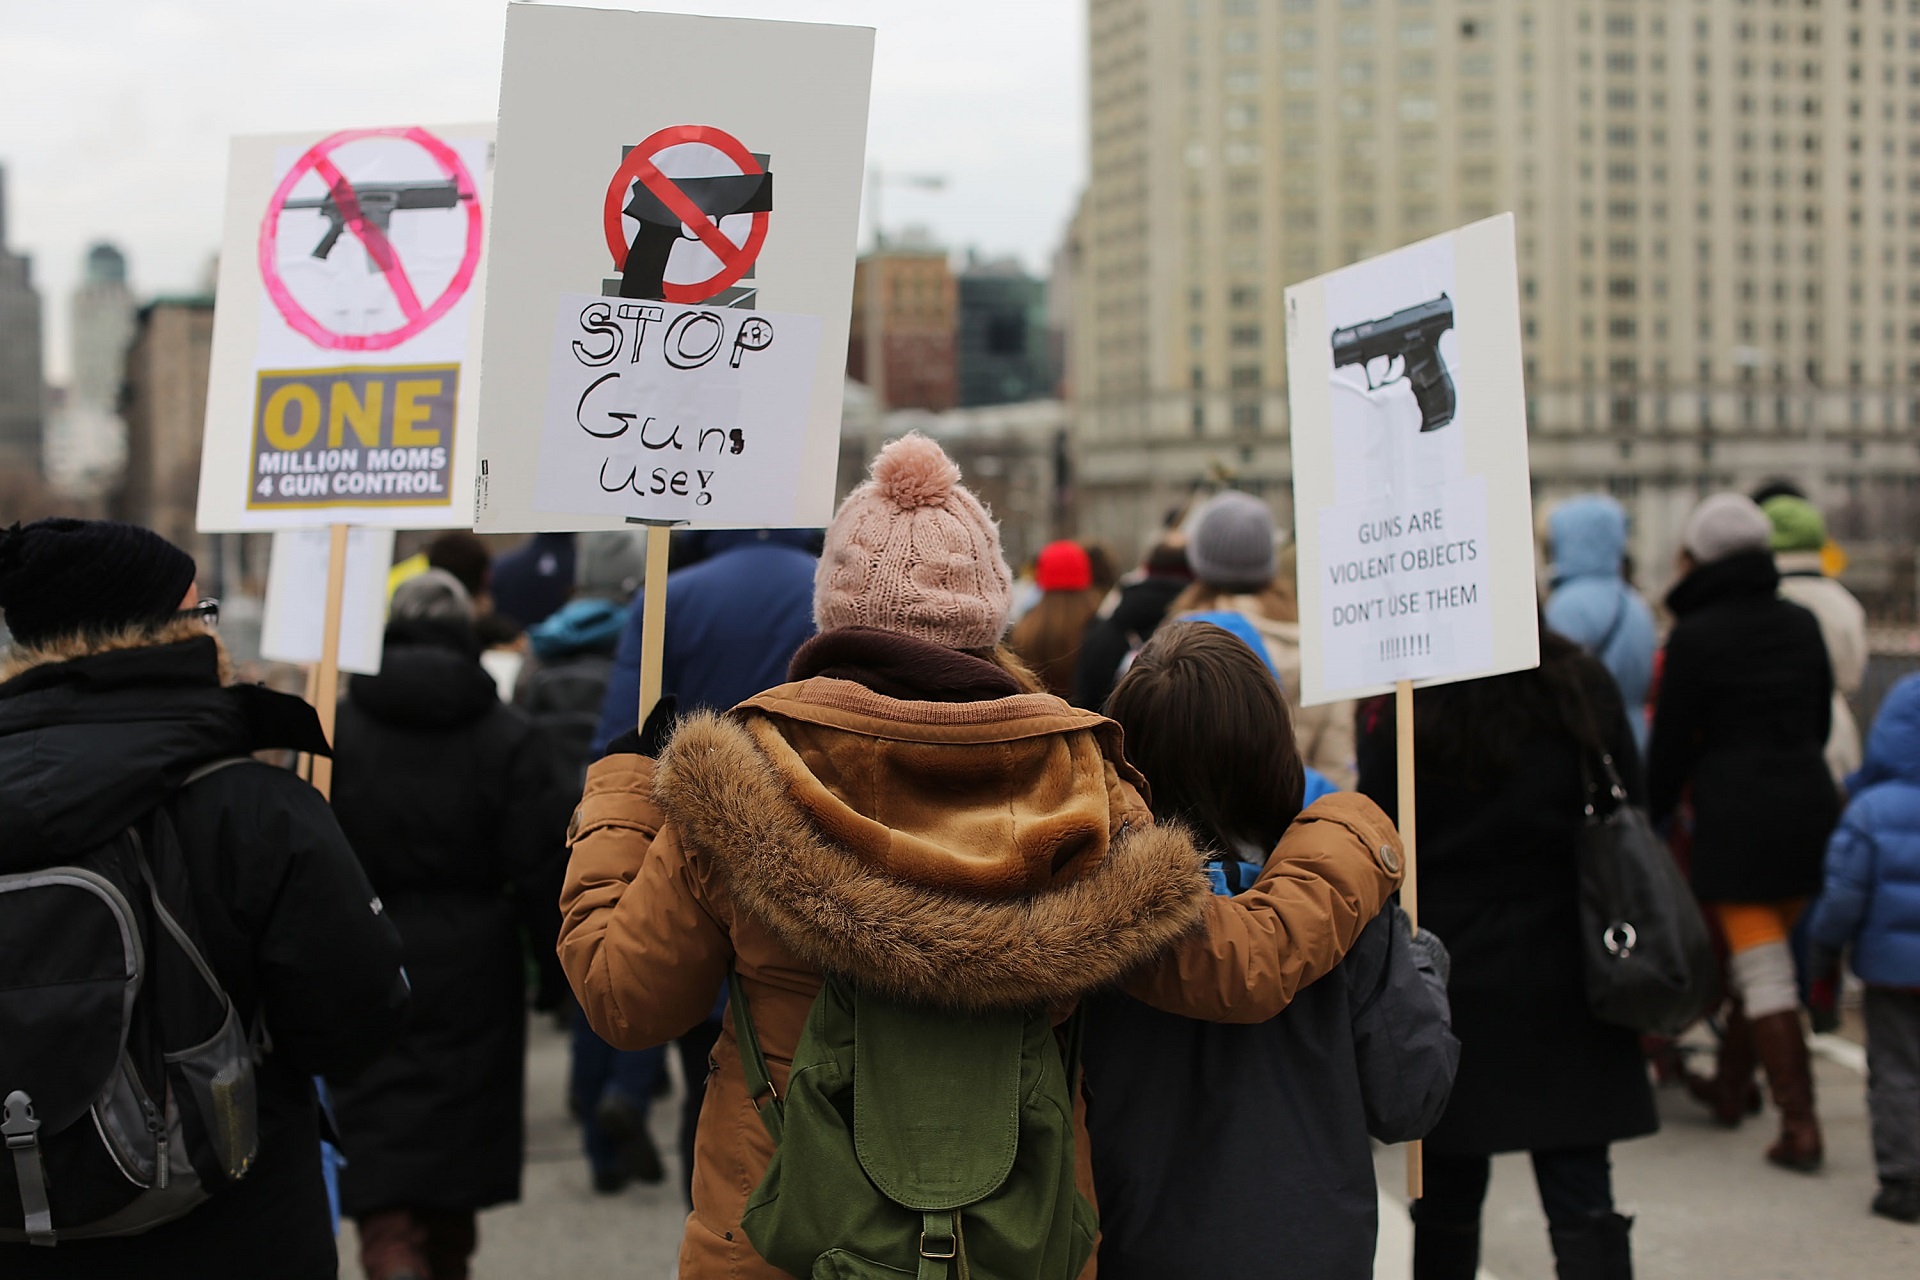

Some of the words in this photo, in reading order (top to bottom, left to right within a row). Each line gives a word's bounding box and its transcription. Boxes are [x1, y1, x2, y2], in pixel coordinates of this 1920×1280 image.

[572, 303, 774, 370] STOP
[263, 379, 443, 452] ONE
[258, 449, 359, 474] MILLION
[366, 447, 446, 471] MOMS
[257, 475, 274, 497] 4
[278, 473, 329, 496] GUN
[332, 471, 444, 494] CONTROL
[1358, 515, 1402, 545] GUNS
[1408, 508, 1443, 534] ARE
[1329, 553, 1396, 585] VIOLENT
[1400, 539, 1477, 572] OBJECTS
[1332, 598, 1384, 627] DON'T
[1388, 592, 1421, 617] USE
[1426, 583, 1478, 611] THEM
